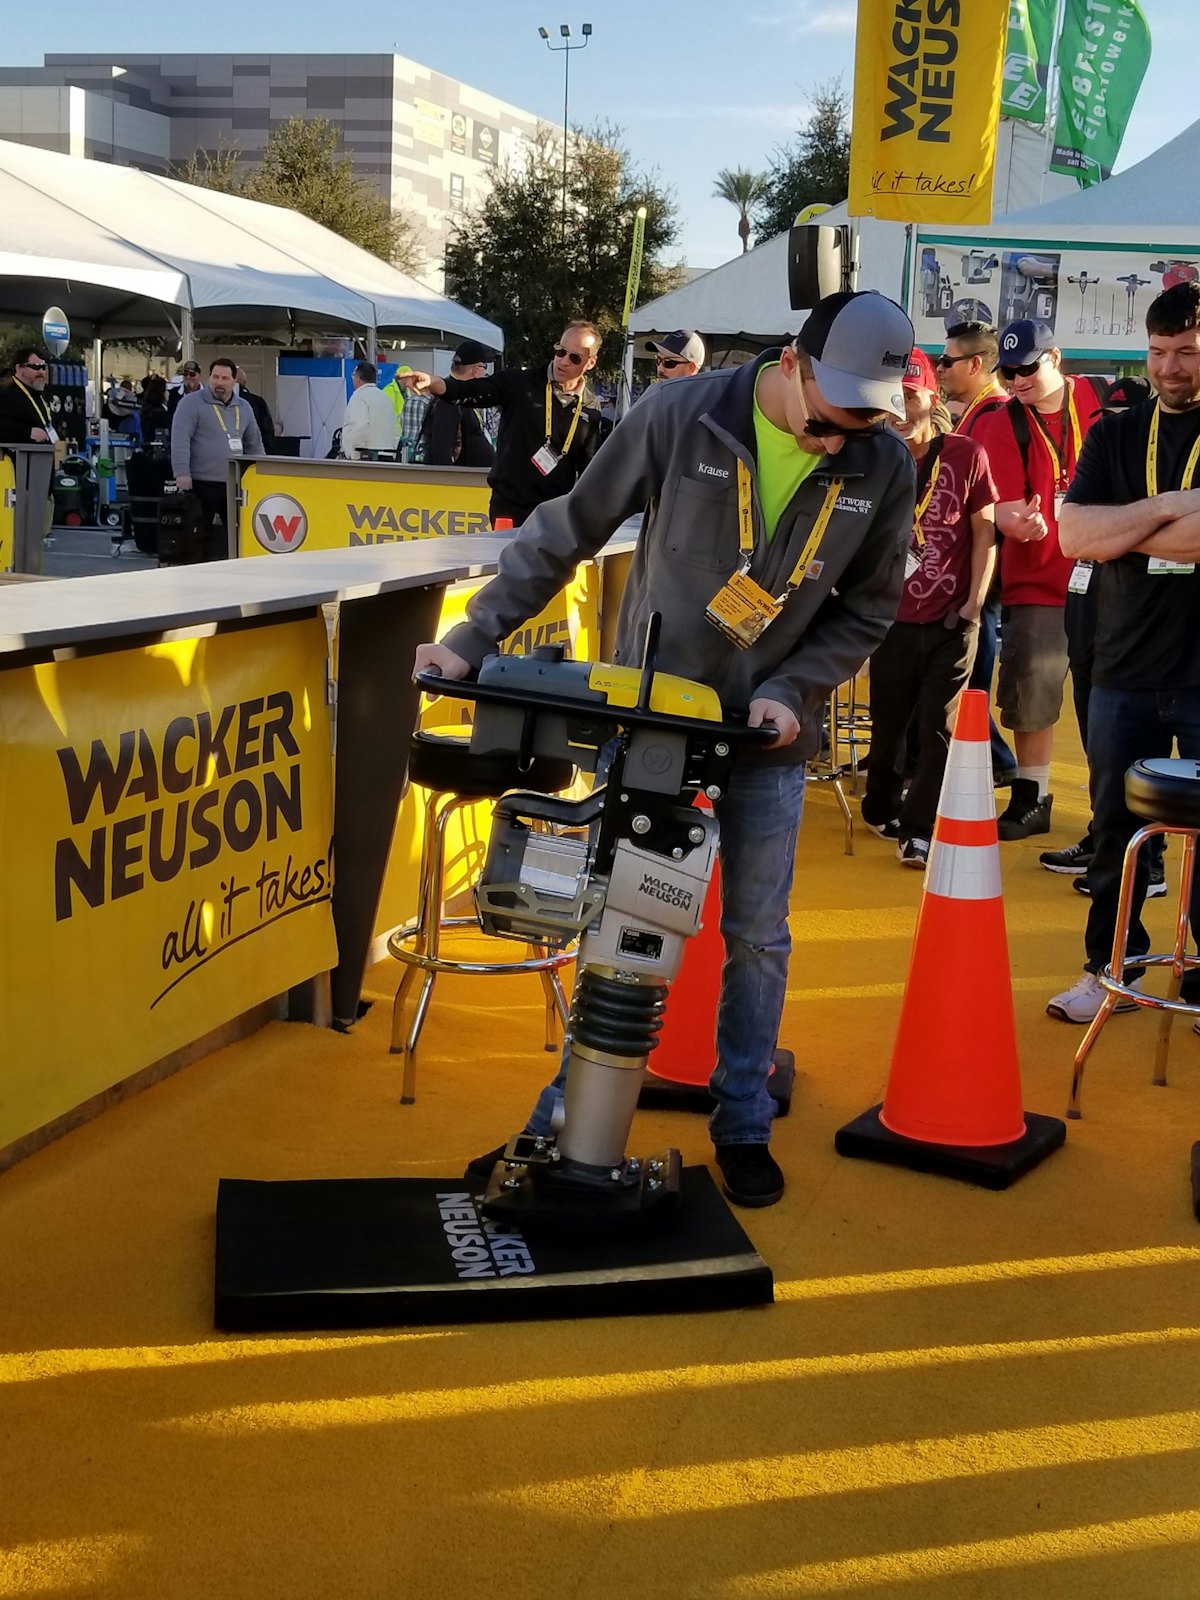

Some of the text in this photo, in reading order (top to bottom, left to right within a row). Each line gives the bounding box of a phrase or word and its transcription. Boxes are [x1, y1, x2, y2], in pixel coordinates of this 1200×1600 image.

[892, 170, 912, 190] it
[915, 171, 976, 193] takes!
[698, 462, 730, 479] Krause
[836, 496, 873, 509] ATWORK
[346, 504, 490, 536] WACKER
[56, 690, 300, 826] WACKER
[55, 764, 302, 922] NEUSON
[162, 835, 335, 970] all it takes!
[638, 882, 691, 911] NEUSON
[643, 873, 694, 901] WACKER
[435, 1192, 496, 1278] NEUSON
[475, 1194, 536, 1276] CKER
